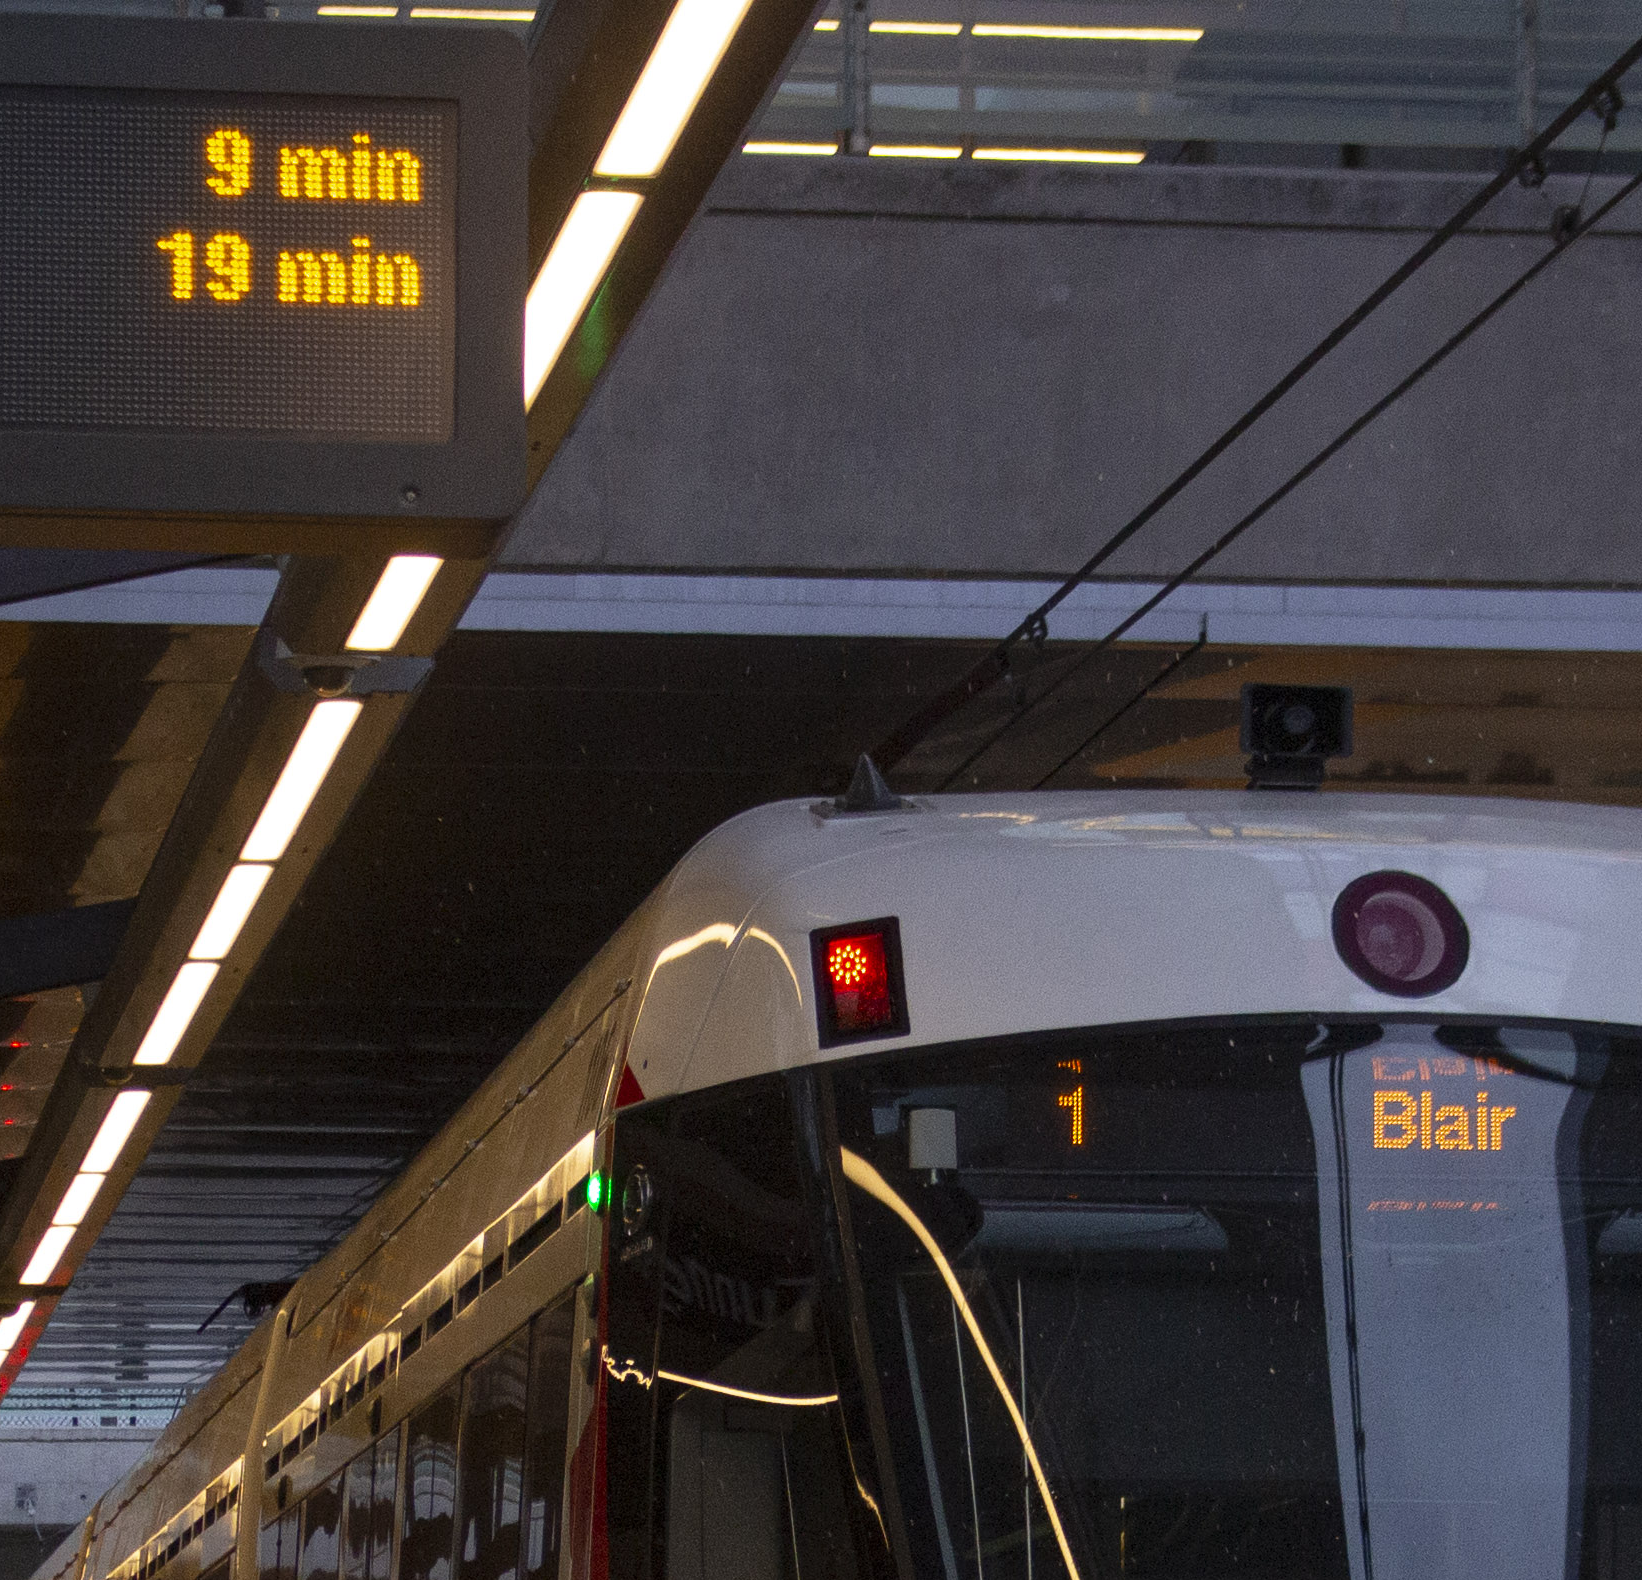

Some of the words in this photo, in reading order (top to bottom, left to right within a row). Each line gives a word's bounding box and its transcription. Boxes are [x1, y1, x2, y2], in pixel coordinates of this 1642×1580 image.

[206, 130, 250, 196] 9
[279, 132, 420, 201] min
[156, 231, 250, 301] 19
[277, 235, 420, 306] min
[1058, 1086, 1082, 1145] 1
[1373, 1091, 1516, 1150] Blair
